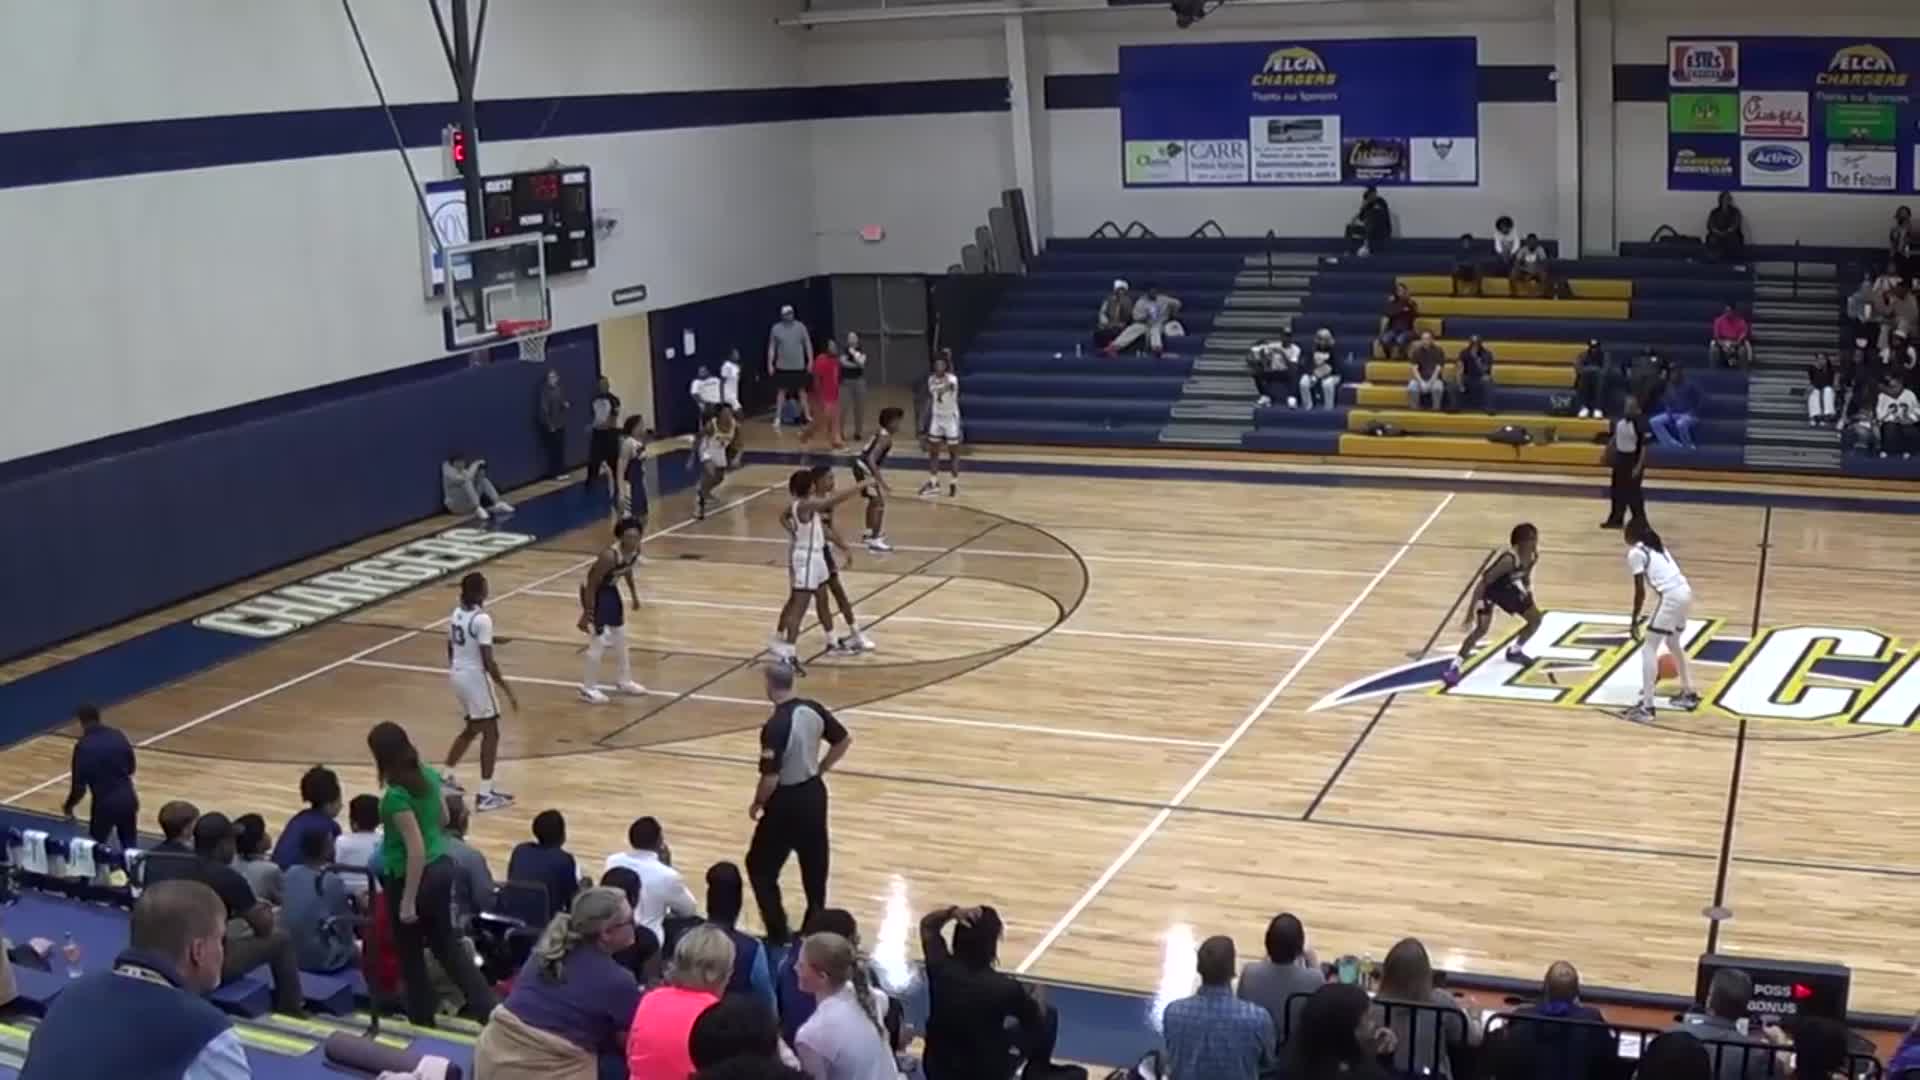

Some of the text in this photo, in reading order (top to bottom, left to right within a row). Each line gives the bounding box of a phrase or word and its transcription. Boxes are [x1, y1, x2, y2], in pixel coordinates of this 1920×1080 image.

[1272, 57, 1316, 71] ELCA
[1839, 56, 1887, 71] ELCA
[1250, 73, 1338, 86] CHARGERS
[1815, 72, 1910, 87] CHARGERS
[1189, 143, 1245, 160] CARR
[1754, 150, 1799, 166] Active
[1830, 171, 1850, 186] The
[192, 528, 536, 639] CHARGERS
[1753, 983, 1792, 998] POSS
